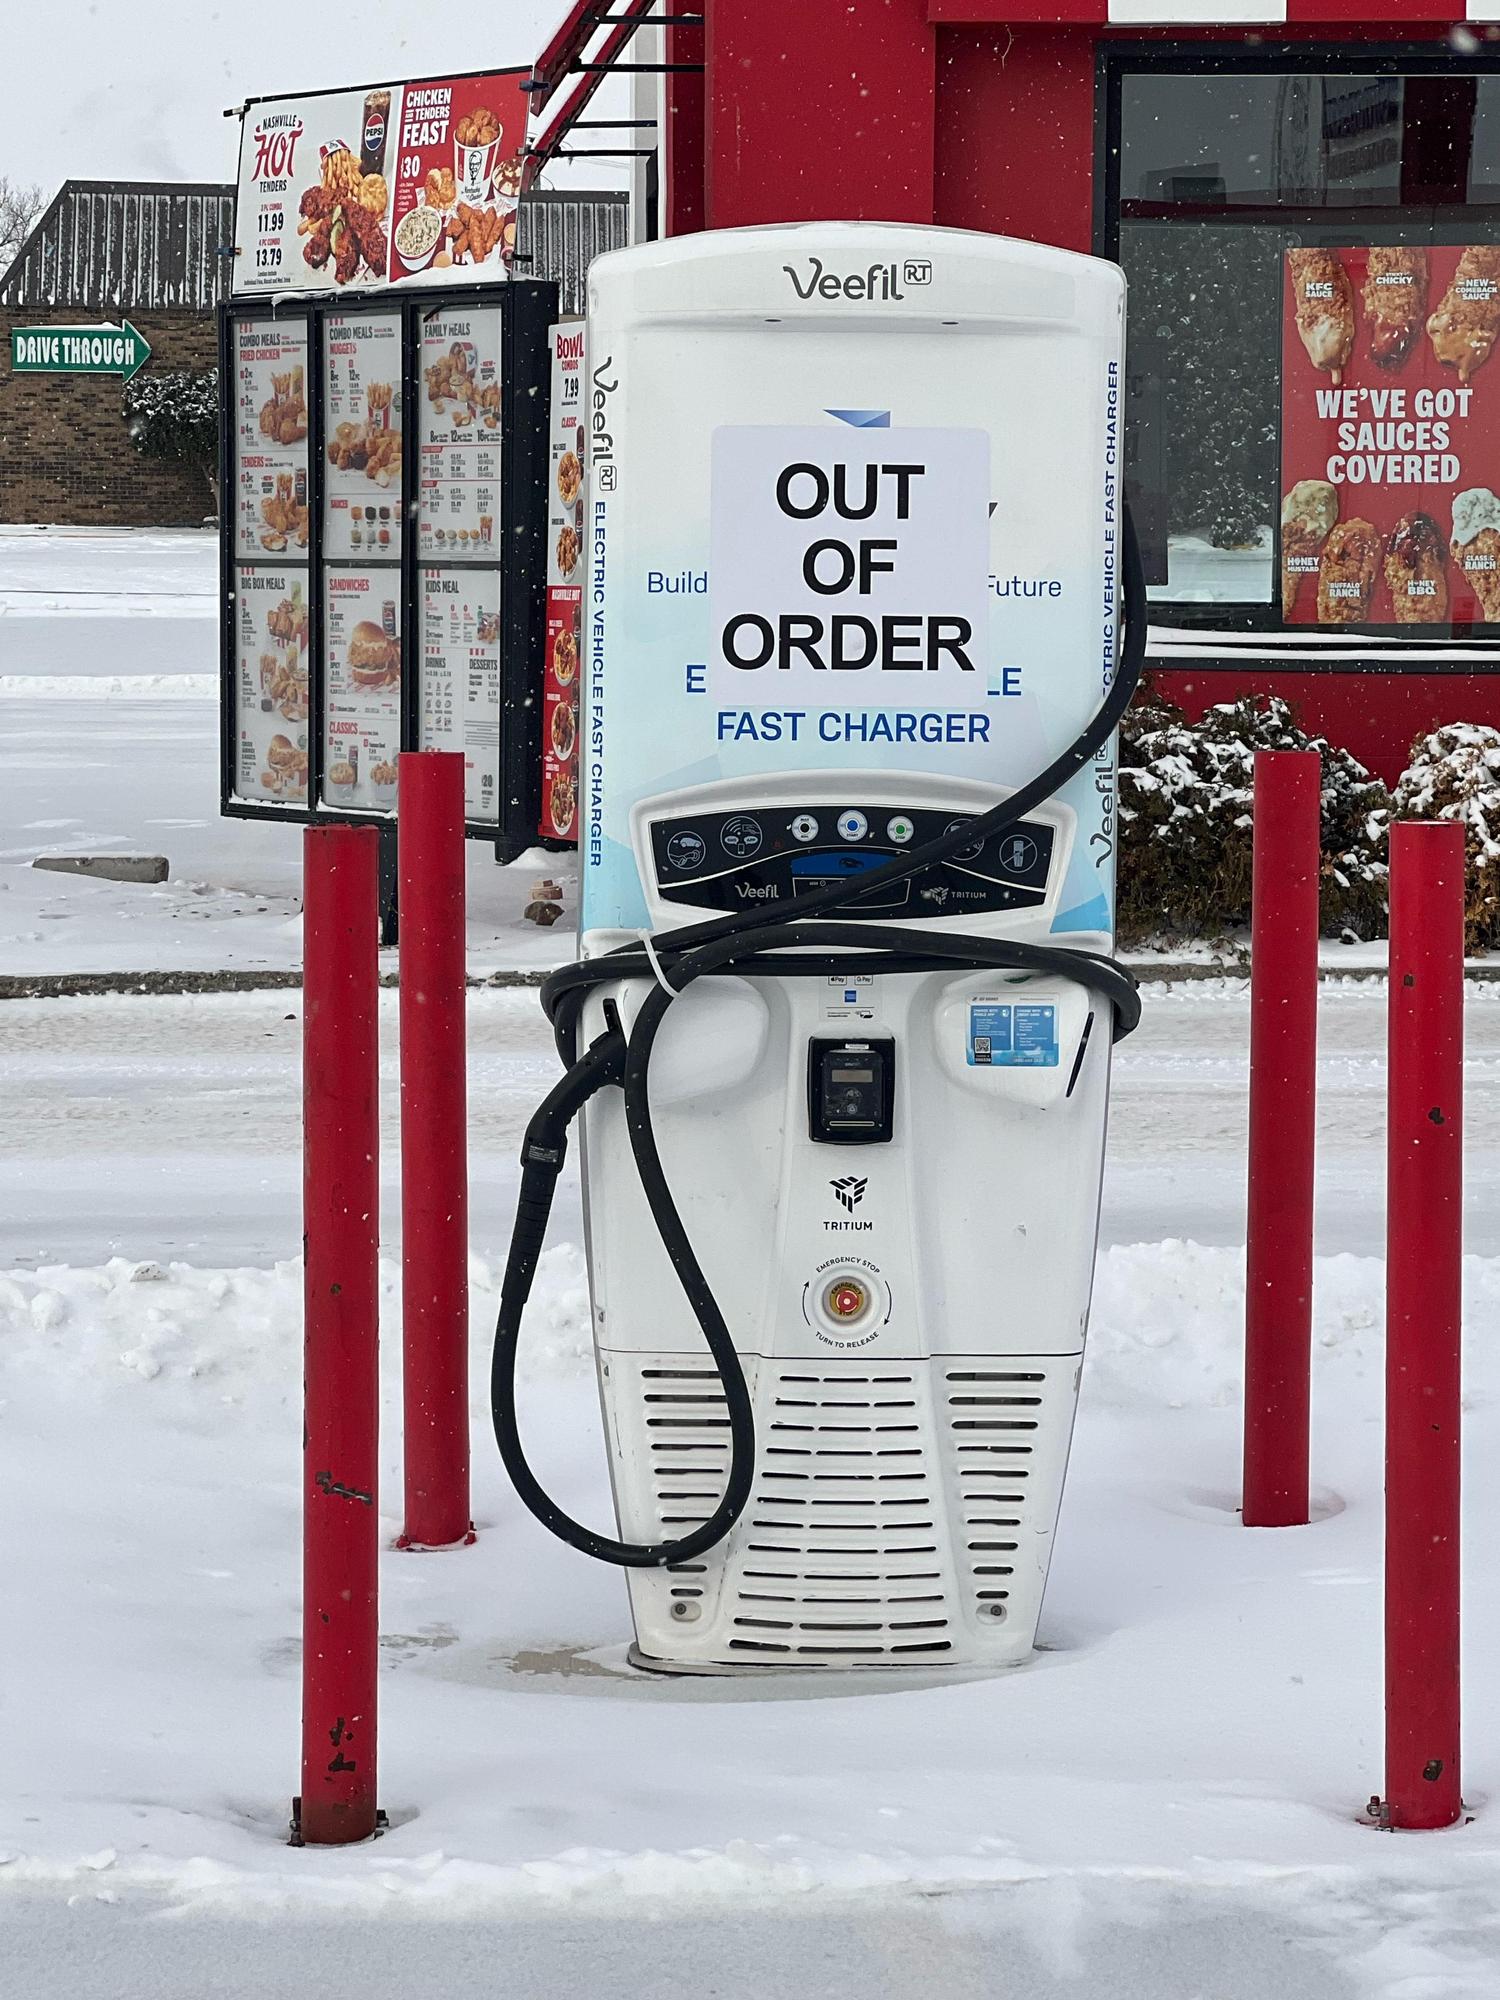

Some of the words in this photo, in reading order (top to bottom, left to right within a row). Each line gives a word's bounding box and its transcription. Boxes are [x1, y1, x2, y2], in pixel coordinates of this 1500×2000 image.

[406, 88, 452, 108] CHICKEN
[416, 106, 450, 120] TENDERS
[263, 115, 297, 130] NASHVILLE
[366, 126, 383, 136] PEPSI
[402, 120, 450, 148] FEAST
[251, 128, 303, 182] HOT
[260, 180, 287, 192] TENDERS
[258, 212, 284, 232] 11.99
[256, 248, 282, 266] 13.79
[783, 258, 904, 300] Veefil
[904, 261, 932, 284] RT
[1306, 282, 1333, 291] KFC
[1376, 276, 1412, 284] CHICKY
[1306, 290, 1332, 298] SAUCE
[330, 328, 351, 340] COMBO
[352, 326, 372, 339] MEALS
[424, 324, 448, 338] FAMILY
[449, 322, 470, 336] MEALS
[240, 334, 260, 348] COMBO
[261, 333, 280, 346] MEALS
[557, 331, 584, 359] BOWL
[16, 336, 59, 362] DRIVE
[62, 337, 134, 365] THROUGH
[256, 348, 280, 360] CHICKEN
[564, 377, 578, 398] 7.99
[593, 356, 618, 466] Veefil
[1106, 361, 1118, 464] CHARGER
[1414, 389, 1473, 418] GOT
[562, 416, 576, 428] CLASSIC
[1338, 422, 1450, 451] SAUCES
[241, 456, 264, 468] TENDERS
[1326, 454, 1460, 484] COVERED
[600, 467, 616, 490] RT
[776, 463, 925, 520] OUT
[1106, 470, 1115, 523] FAST
[594, 501, 606, 603] ELECTRIC
[803, 538, 898, 595] OF
[1288, 557, 1320, 566] HONEY
[1464, 561, 1496, 570] RANCH
[1104, 530, 1115, 618] VEHICLE
[242, 577, 252, 590] BIG
[252, 578, 265, 590] BOX
[266, 578, 286, 590] MEALS
[330, 578, 370, 591] SANDWICHES
[426, 580, 440, 593] KIDS
[442, 580, 460, 593] MEAL
[1330, 588, 1360, 597] RANCH
[1408, 586, 1436, 596] BBQ
[722, 614, 976, 672] ORDER
[593, 610, 604, 698] VEHICLE
[426, 657, 446, 668] DRINKS
[469, 659, 498, 670] DESSERTS
[330, 721, 358, 735] CLASSICS
[592, 705, 604, 758] FAST
[718, 712, 806, 741] FAST
[818, 714, 990, 743] CHARGER
[590, 764, 602, 866] CHARGER
[1090, 761, 1114, 868] Veefil
[735, 882, 779, 898] Veefil
[823, 1222, 873, 1230] TRITIUM
[816, 1256, 861, 1273] EMERGENCY
[862, 1260, 880, 1274] STOP
[831, 1282, 862, 1294] EMERGENCY
[815, 1331, 834, 1346] TURN
[846, 1332, 880, 1348] RELEASE
